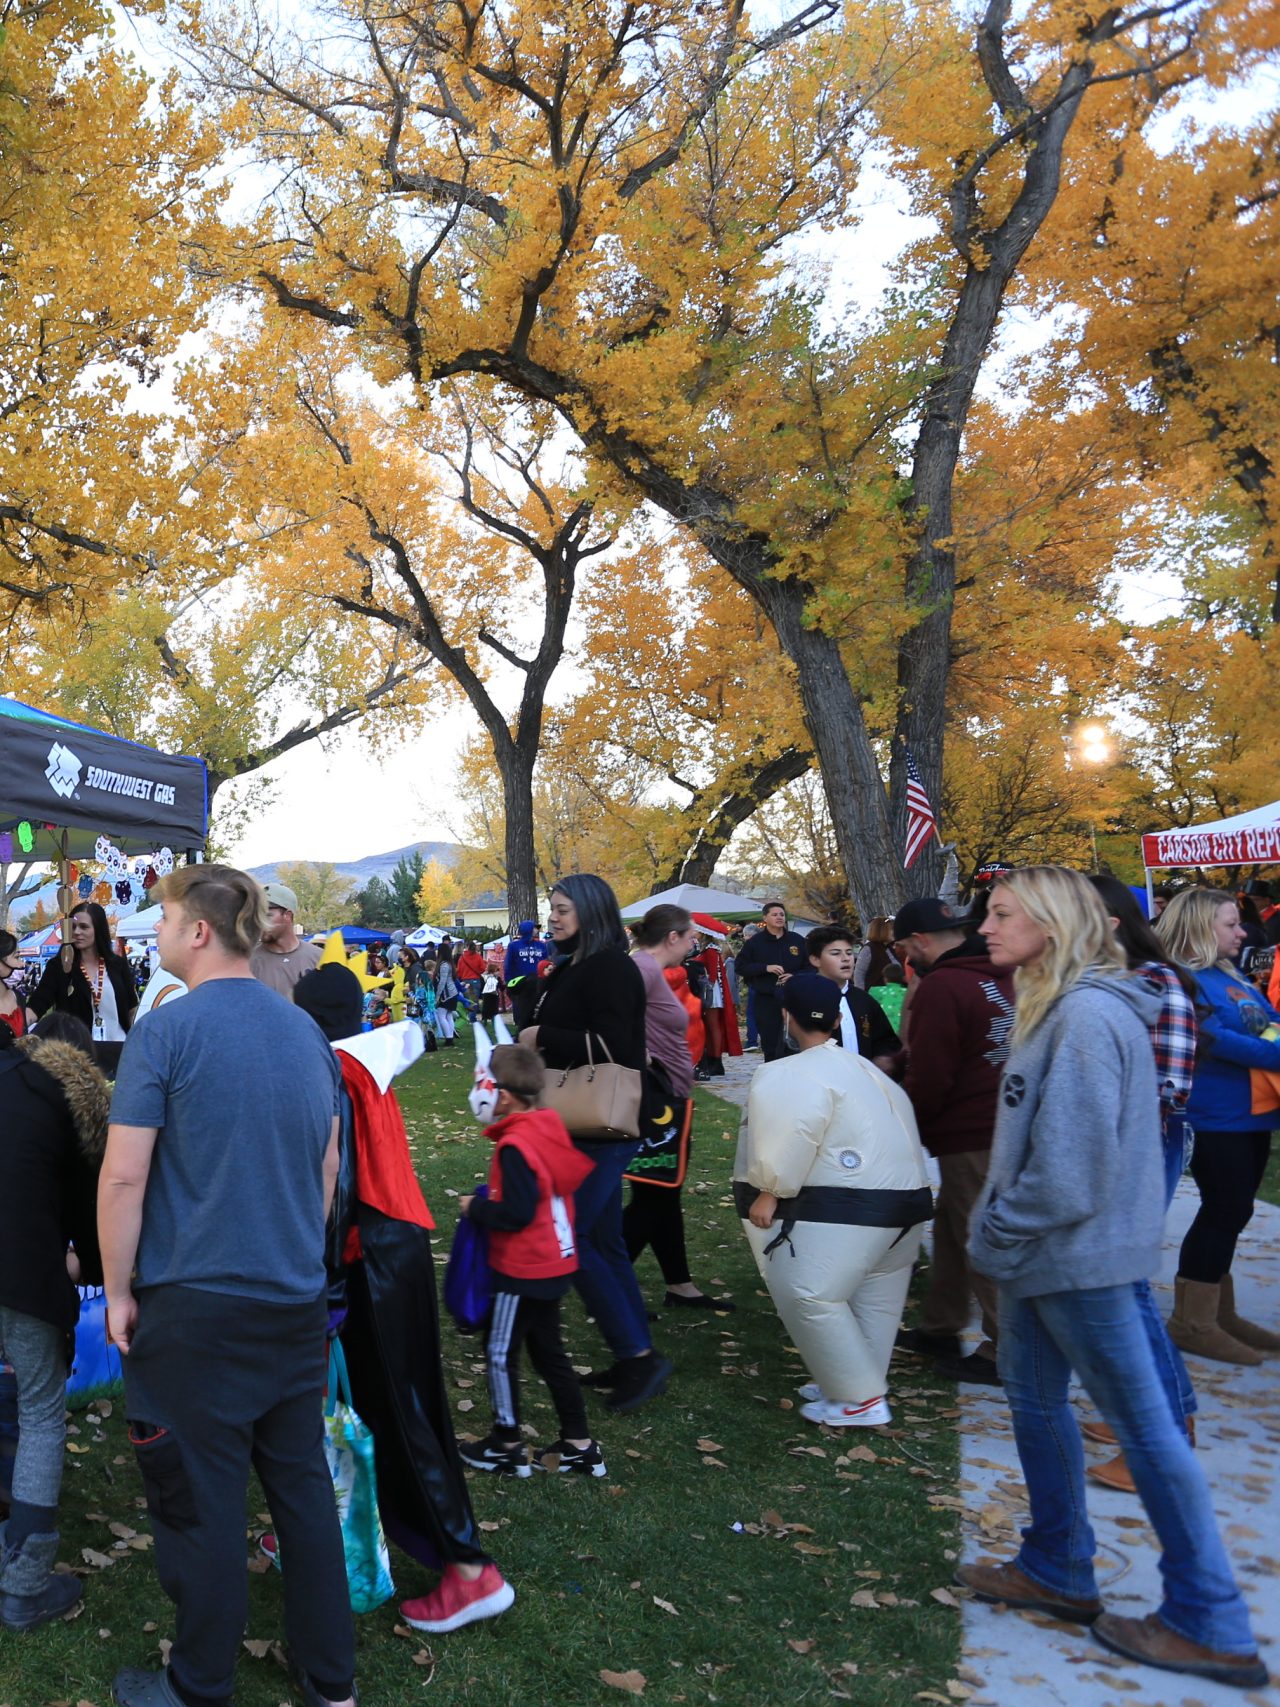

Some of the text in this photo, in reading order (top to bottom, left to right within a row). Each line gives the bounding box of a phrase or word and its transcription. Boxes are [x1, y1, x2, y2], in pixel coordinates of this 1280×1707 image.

[85, 766, 176, 805] SOUTHWEST GAS
[1158, 834, 1211, 863] CARSON
[1212, 829, 1243, 860] CITY
